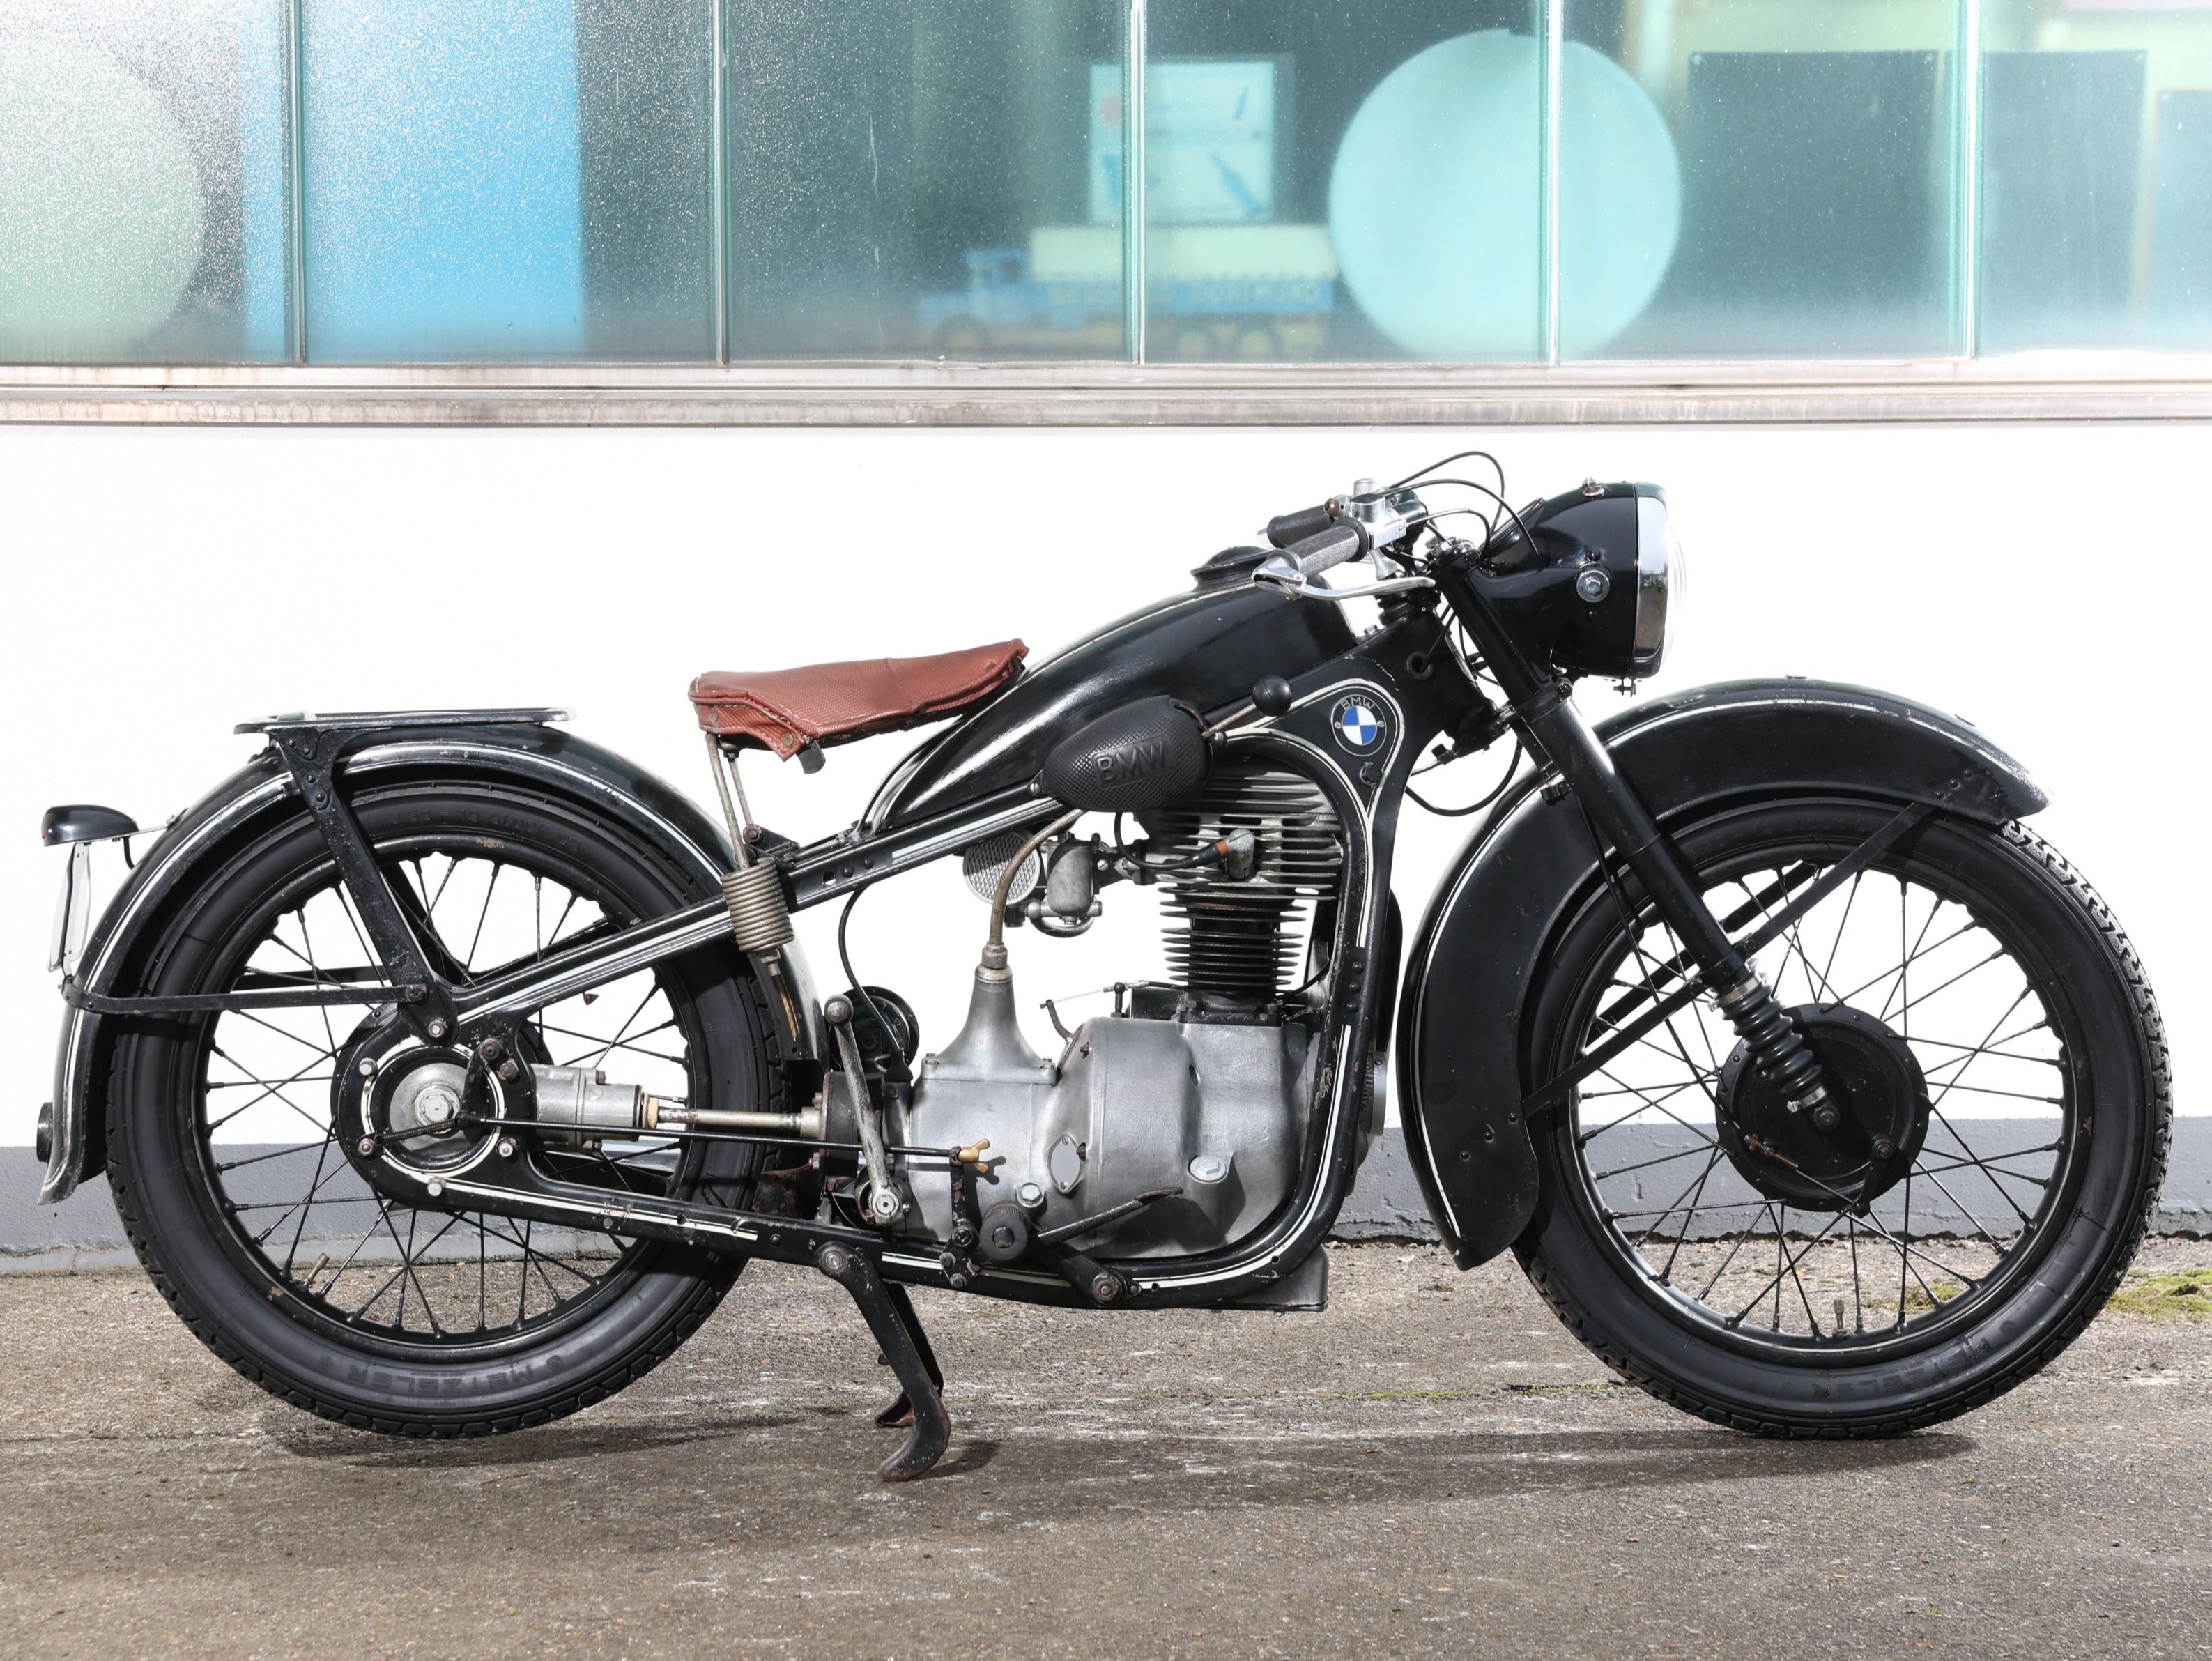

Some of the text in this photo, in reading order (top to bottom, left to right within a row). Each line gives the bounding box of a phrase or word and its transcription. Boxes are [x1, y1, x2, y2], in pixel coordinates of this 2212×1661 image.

[1340, 696, 1375, 710] BMW
[1096, 740, 1166, 783] BMW
[490, 811, 551, 839] BLOCK
[346, 1365, 534, 1395] METZELER
[1811, 1339, 1992, 1400] METZELER
